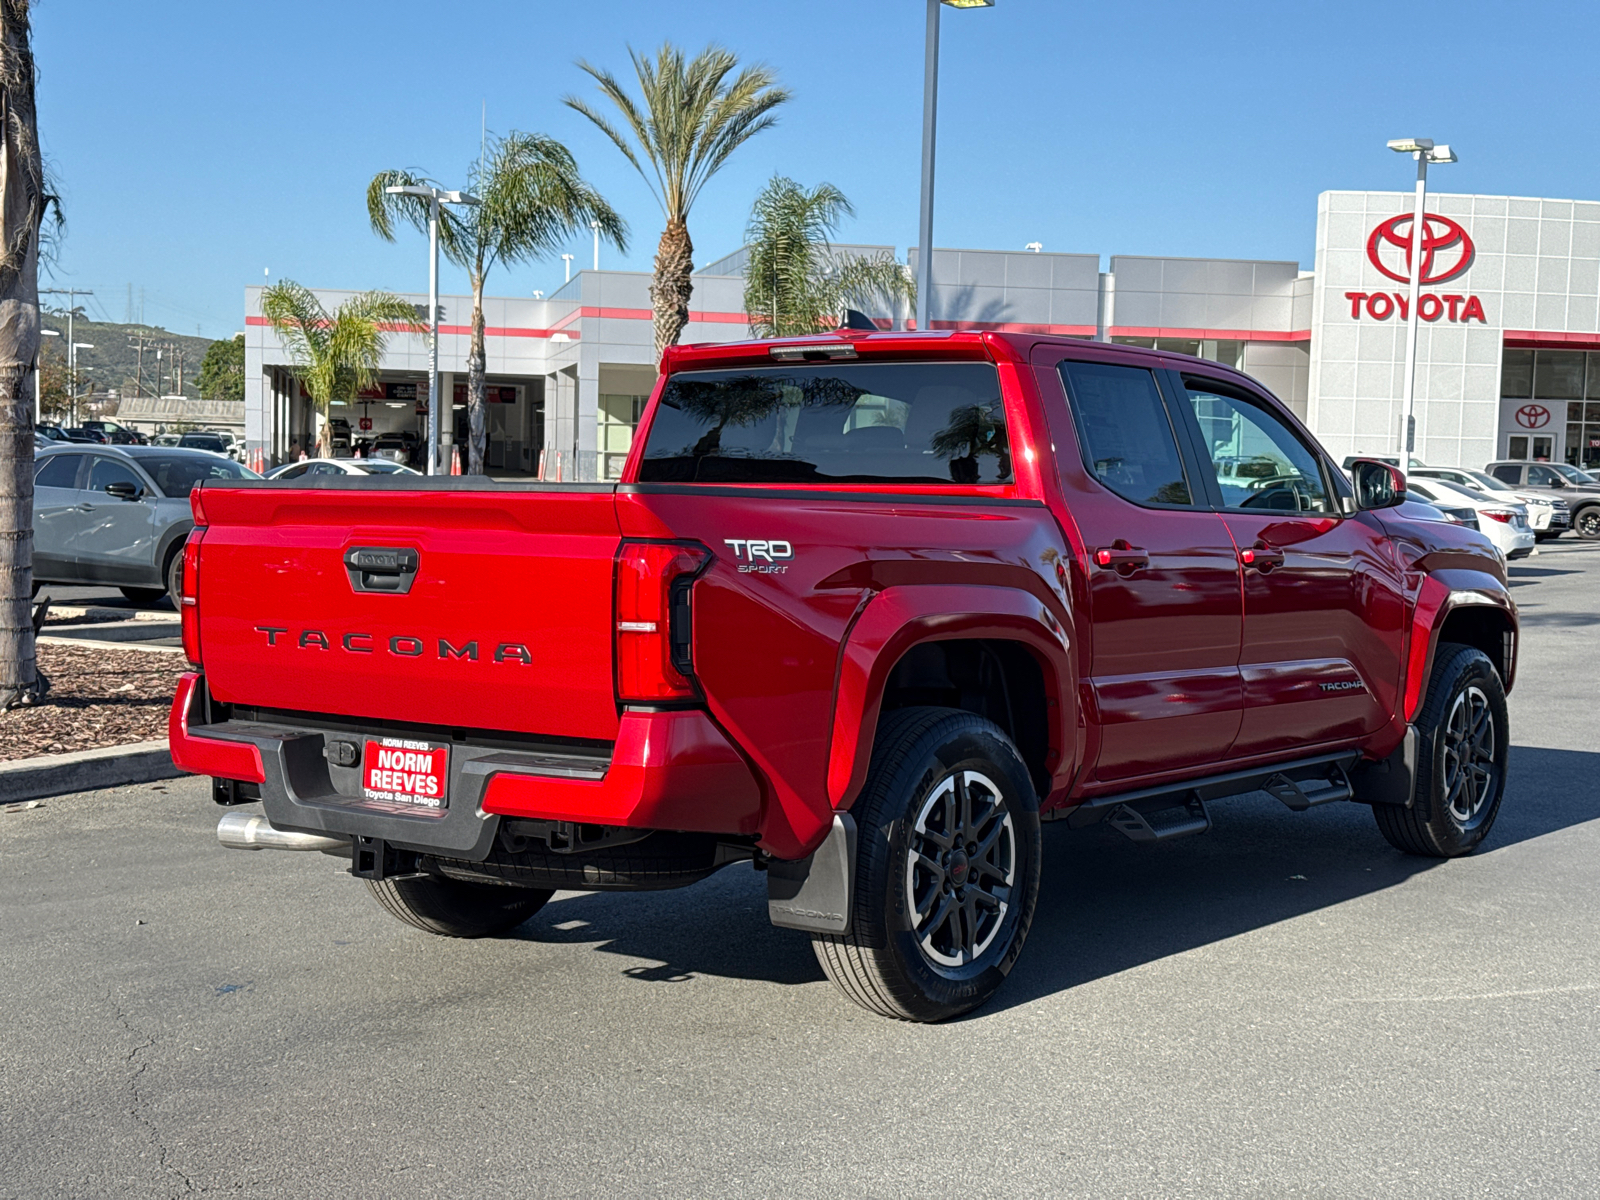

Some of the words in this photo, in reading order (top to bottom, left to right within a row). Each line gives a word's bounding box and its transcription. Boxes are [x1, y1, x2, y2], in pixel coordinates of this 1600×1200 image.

[1345, 292, 1487, 323] TOYOTA
[360, 554, 395, 565] TOYOTA
[724, 539, 794, 564] TRD
[737, 565, 788, 574] SPORT
[255, 626, 533, 665] TACOMA
[1319, 680, 1364, 691] TACOMA
[382, 738, 403, 748] NORM
[403, 740, 429, 750] REEVES
[378, 750, 433, 773] NORM
[370, 769, 438, 795] REEVES
[363, 788, 393, 800] Toyota
[394, 792, 412, 803] San
[414, 795, 440, 807] Diego
[771, 905, 844, 922] TACOMA
